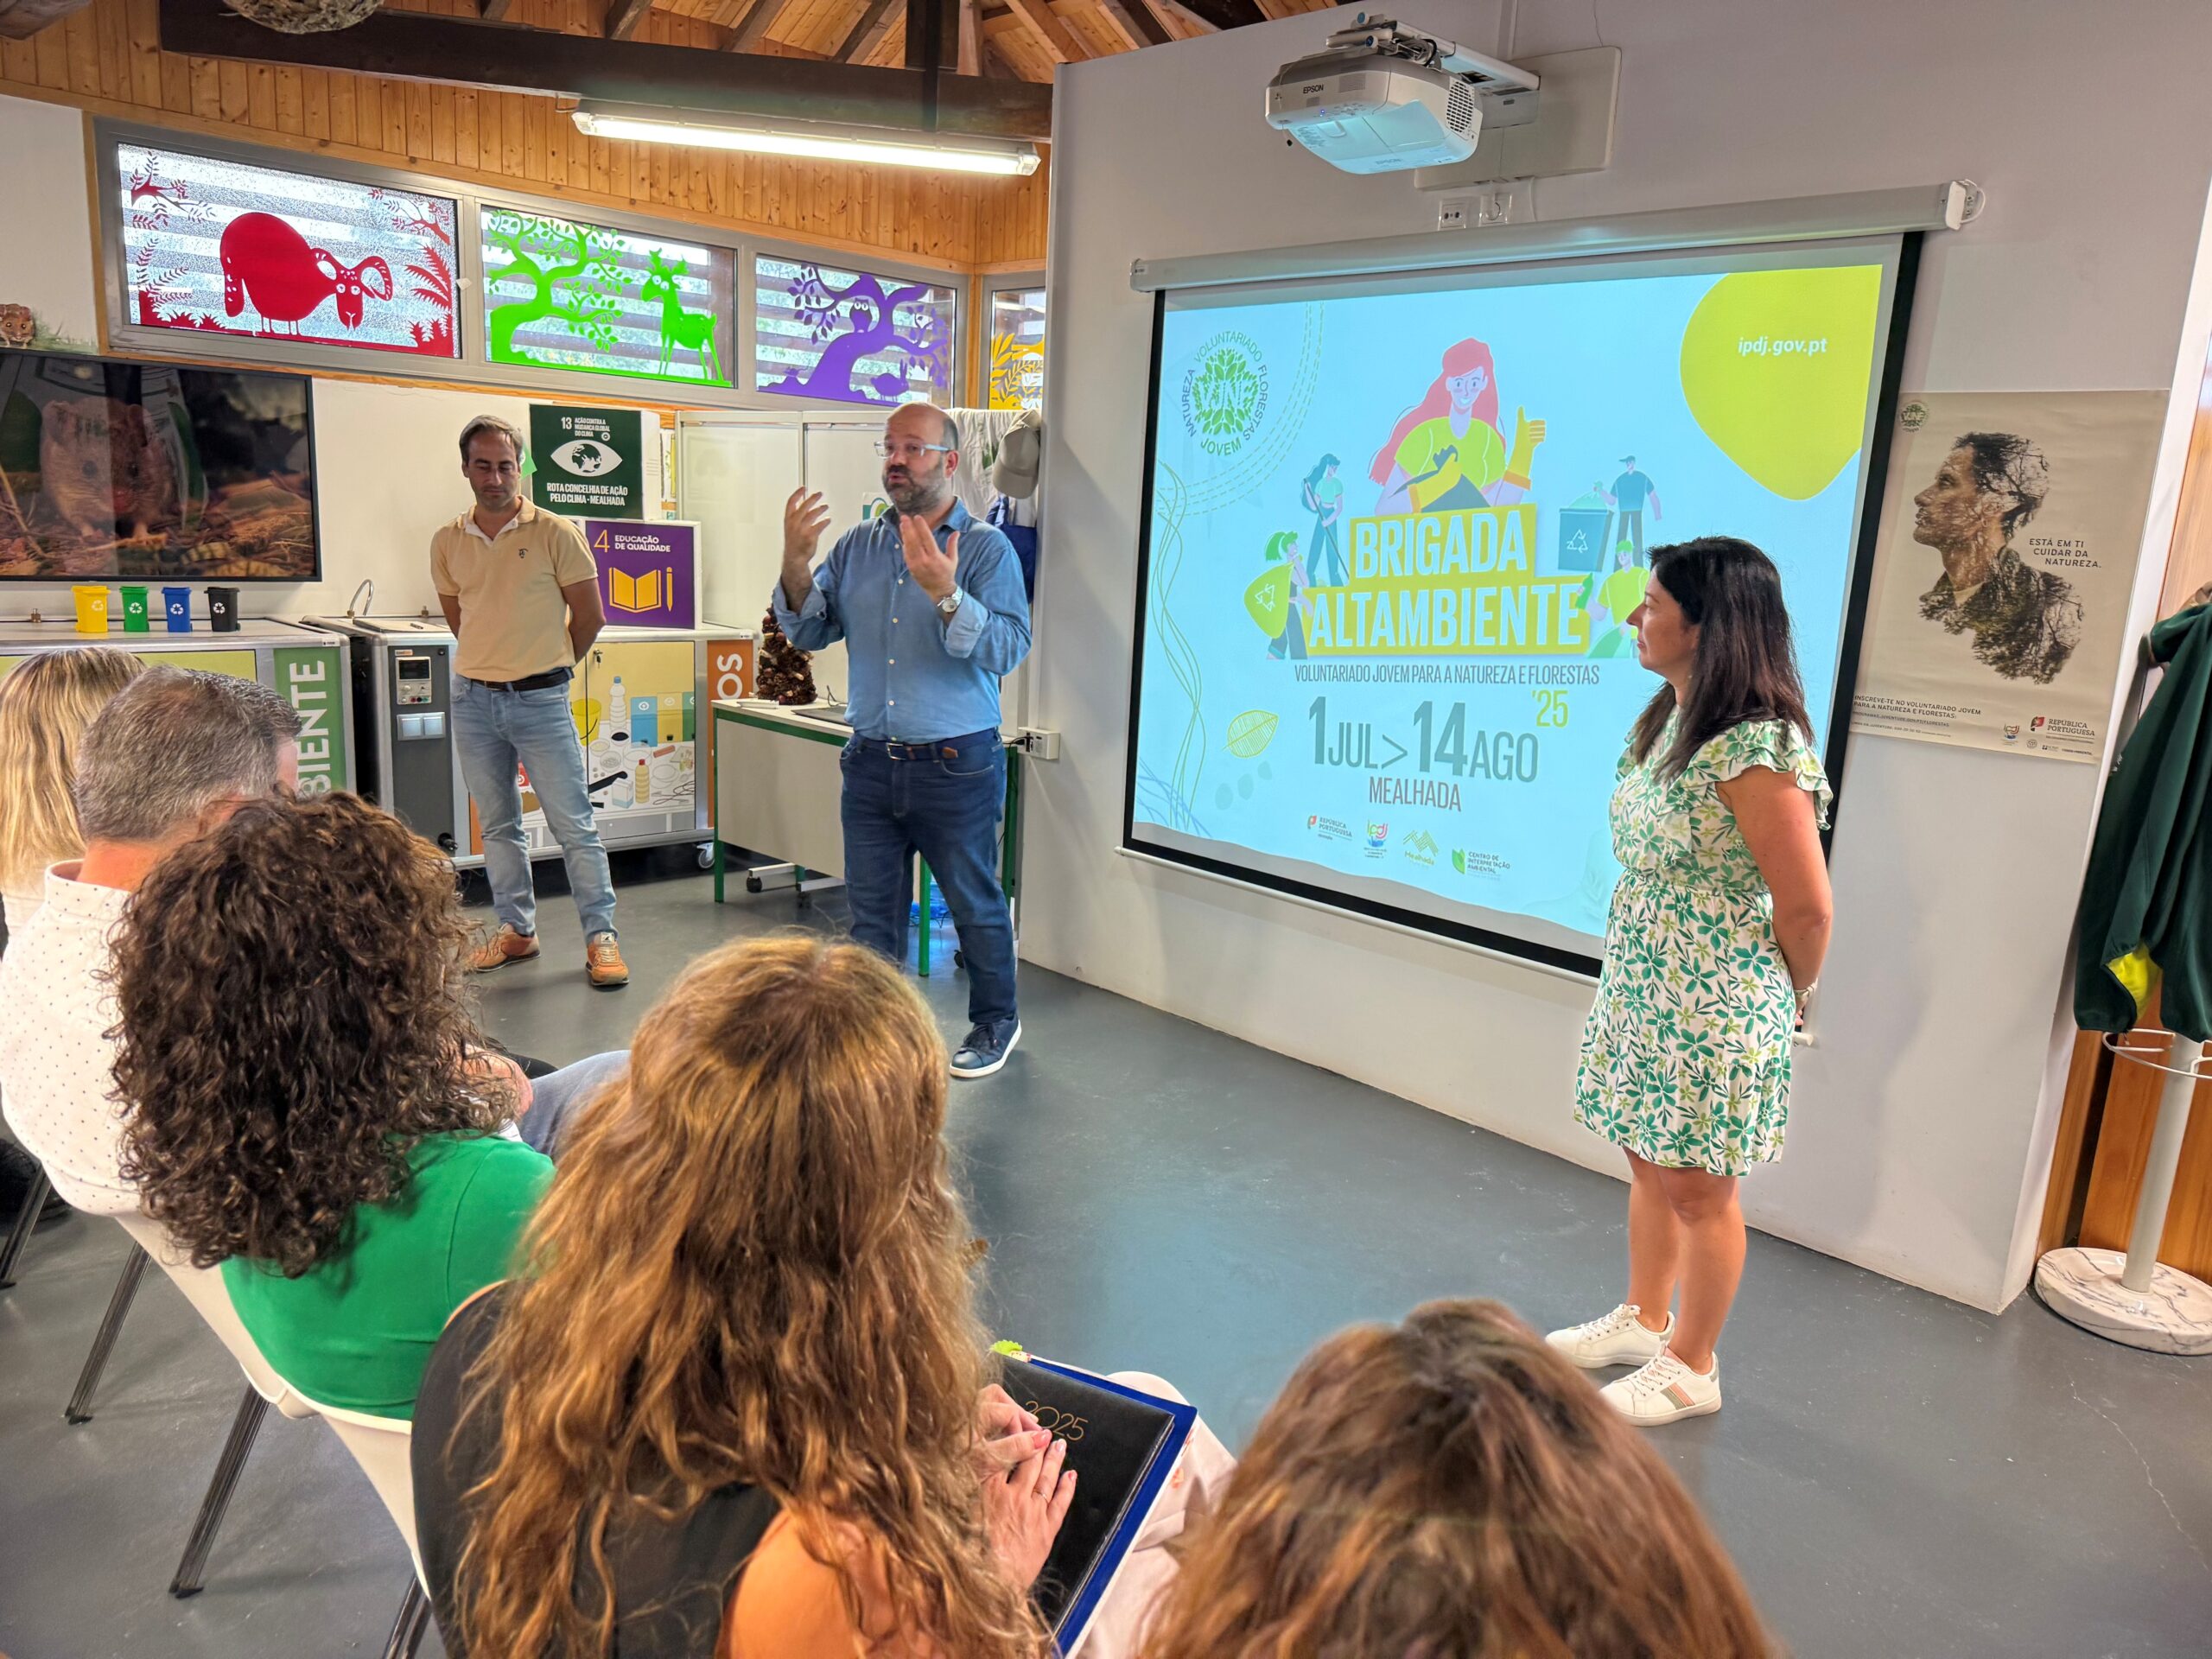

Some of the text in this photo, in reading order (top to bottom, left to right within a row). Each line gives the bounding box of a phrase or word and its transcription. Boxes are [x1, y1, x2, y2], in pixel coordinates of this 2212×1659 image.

[1303, 84, 1324, 94] EPSON
[1194, 331, 1262, 363] VOLUNTARIADO
[1738, 336, 1827, 357] ipdj.gov.pt
[1182, 369, 1196, 437] NATUREZA
[1243, 365, 1268, 441] FLORESTAS
[561, 416, 572, 429] 13
[1201, 436, 1242, 456] JOVEM
[547, 483, 628, 496] ROTA CONCELHIA DE AÇÃO
[550, 493, 566, 503] PELO
[566, 494, 587, 504] CLIMA
[590, 495, 626, 505] MEALHADA
[594, 530, 610, 553] 4
[615, 535, 659, 544] EDUCAÇÃO
[1356, 510, 1528, 578] BRIGADA
[2030, 537, 2053, 546] ESTÁ
[627, 543, 671, 552] QUALIDADE
[2033, 548, 2071, 556] CUIDAR
[2044, 558, 2102, 569] NATUREZA.
[1309, 583, 1582, 647] ALTAMBIENTE
[1294, 664, 1599, 685] VOLUNTARIADO JOVEM PARA A NATUREZA E FLORESTAS
[1853, 695, 1894, 705] INSCREVE-TE
[1906, 702, 1956, 712] VOLUNTARIADO
[1958, 707, 1981, 715] JOVEM
[1878, 705, 1911, 714] NATUREZA
[2047, 725, 2094, 736] PORTUGUESA
[1369, 776, 1461, 812] MEALHADA
[1469, 851, 1491, 861] CENTRO
